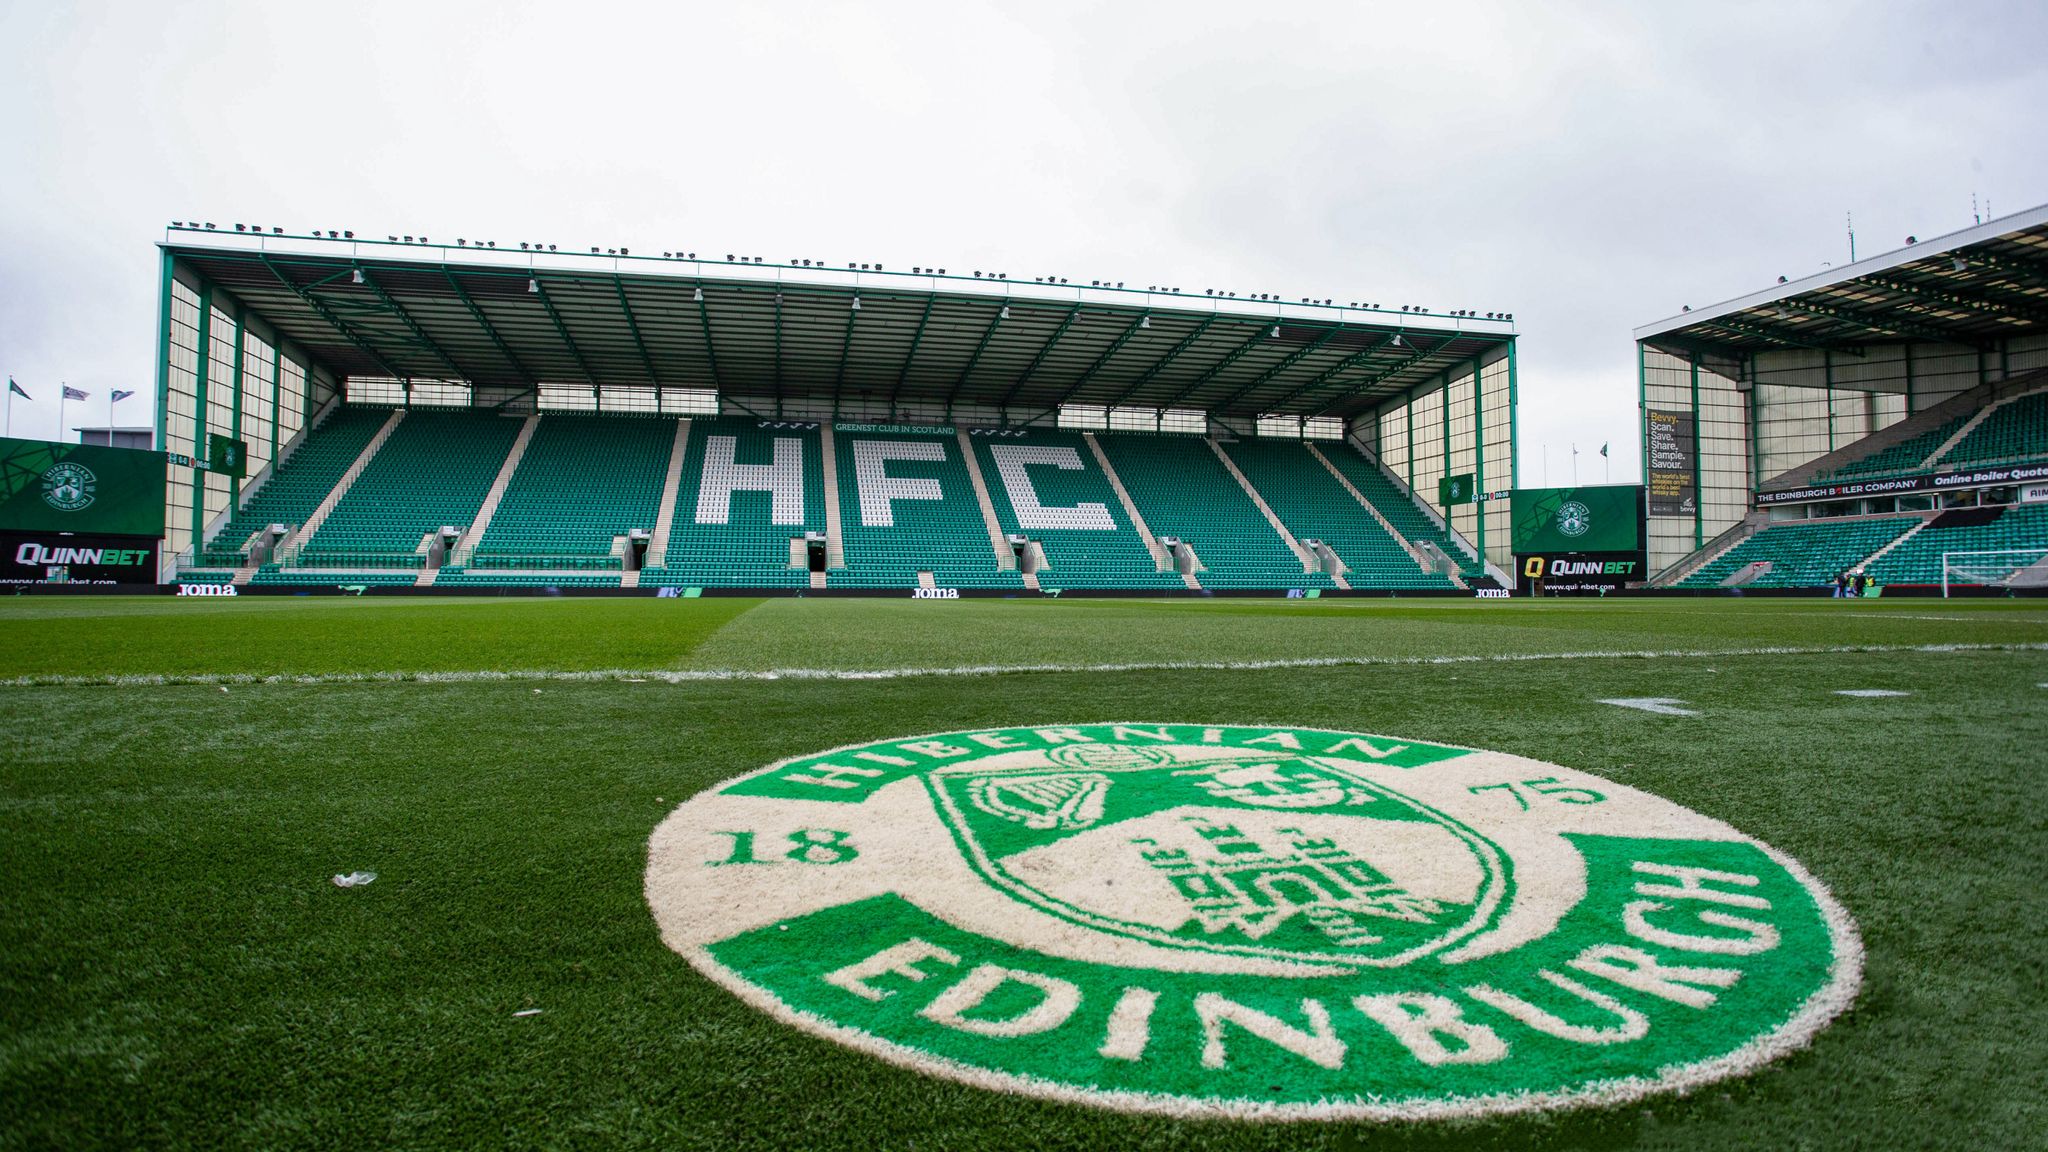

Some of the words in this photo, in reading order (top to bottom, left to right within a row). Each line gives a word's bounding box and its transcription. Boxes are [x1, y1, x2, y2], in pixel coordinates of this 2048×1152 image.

[1651, 412, 1679, 424] Bevvy.
[835, 423, 877, 432] GREENEST
[878, 425, 900, 433] CLUB
[901, 425, 910, 433] IN
[911, 426, 955, 435] SCOTLAND
[1651, 422, 1674, 431] Scan.
[1651, 431, 1674, 441] Save.
[1651, 441, 1679, 450] Share.
[1651, 450, 1685, 461] Sample.
[1651, 459, 1682, 469] Savour.
[1758, 494, 1774, 502] THE
[1775, 488, 1827, 500] EDINBURGH
[1864, 480, 1917, 492] COMPANY
[1934, 475, 1972, 486] Online
[1973, 472, 2010, 482] Boiler
[781, 725, 1410, 789] HIBERNIAN
[1467, 776, 1608, 812] 75
[703, 827, 861, 866] 18
[823, 860, 1781, 1071] EDINBURGH
